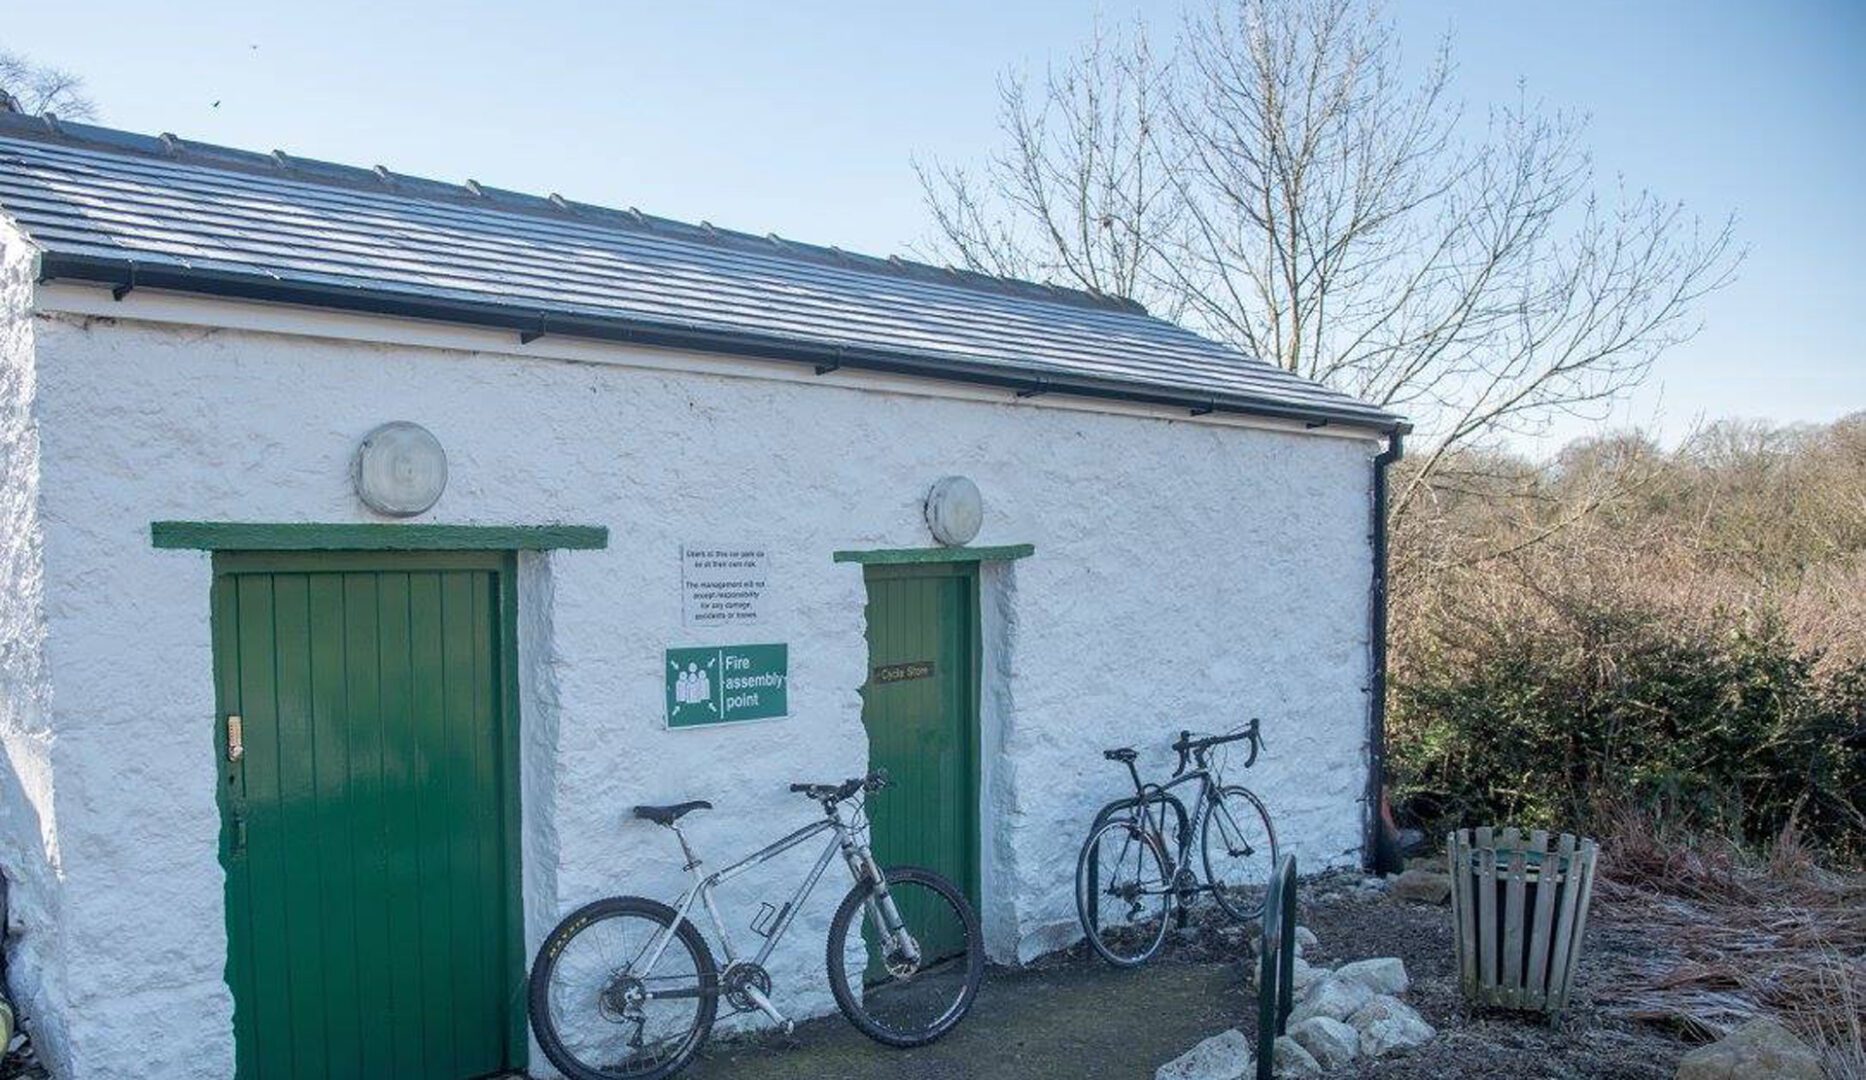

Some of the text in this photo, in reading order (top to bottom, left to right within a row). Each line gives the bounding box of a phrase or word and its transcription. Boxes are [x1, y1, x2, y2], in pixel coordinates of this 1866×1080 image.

[686, 581, 698, 589] The
[725, 655, 750, 670] Fire
[725, 671, 783, 689] assembly
[726, 692, 759, 712] point
